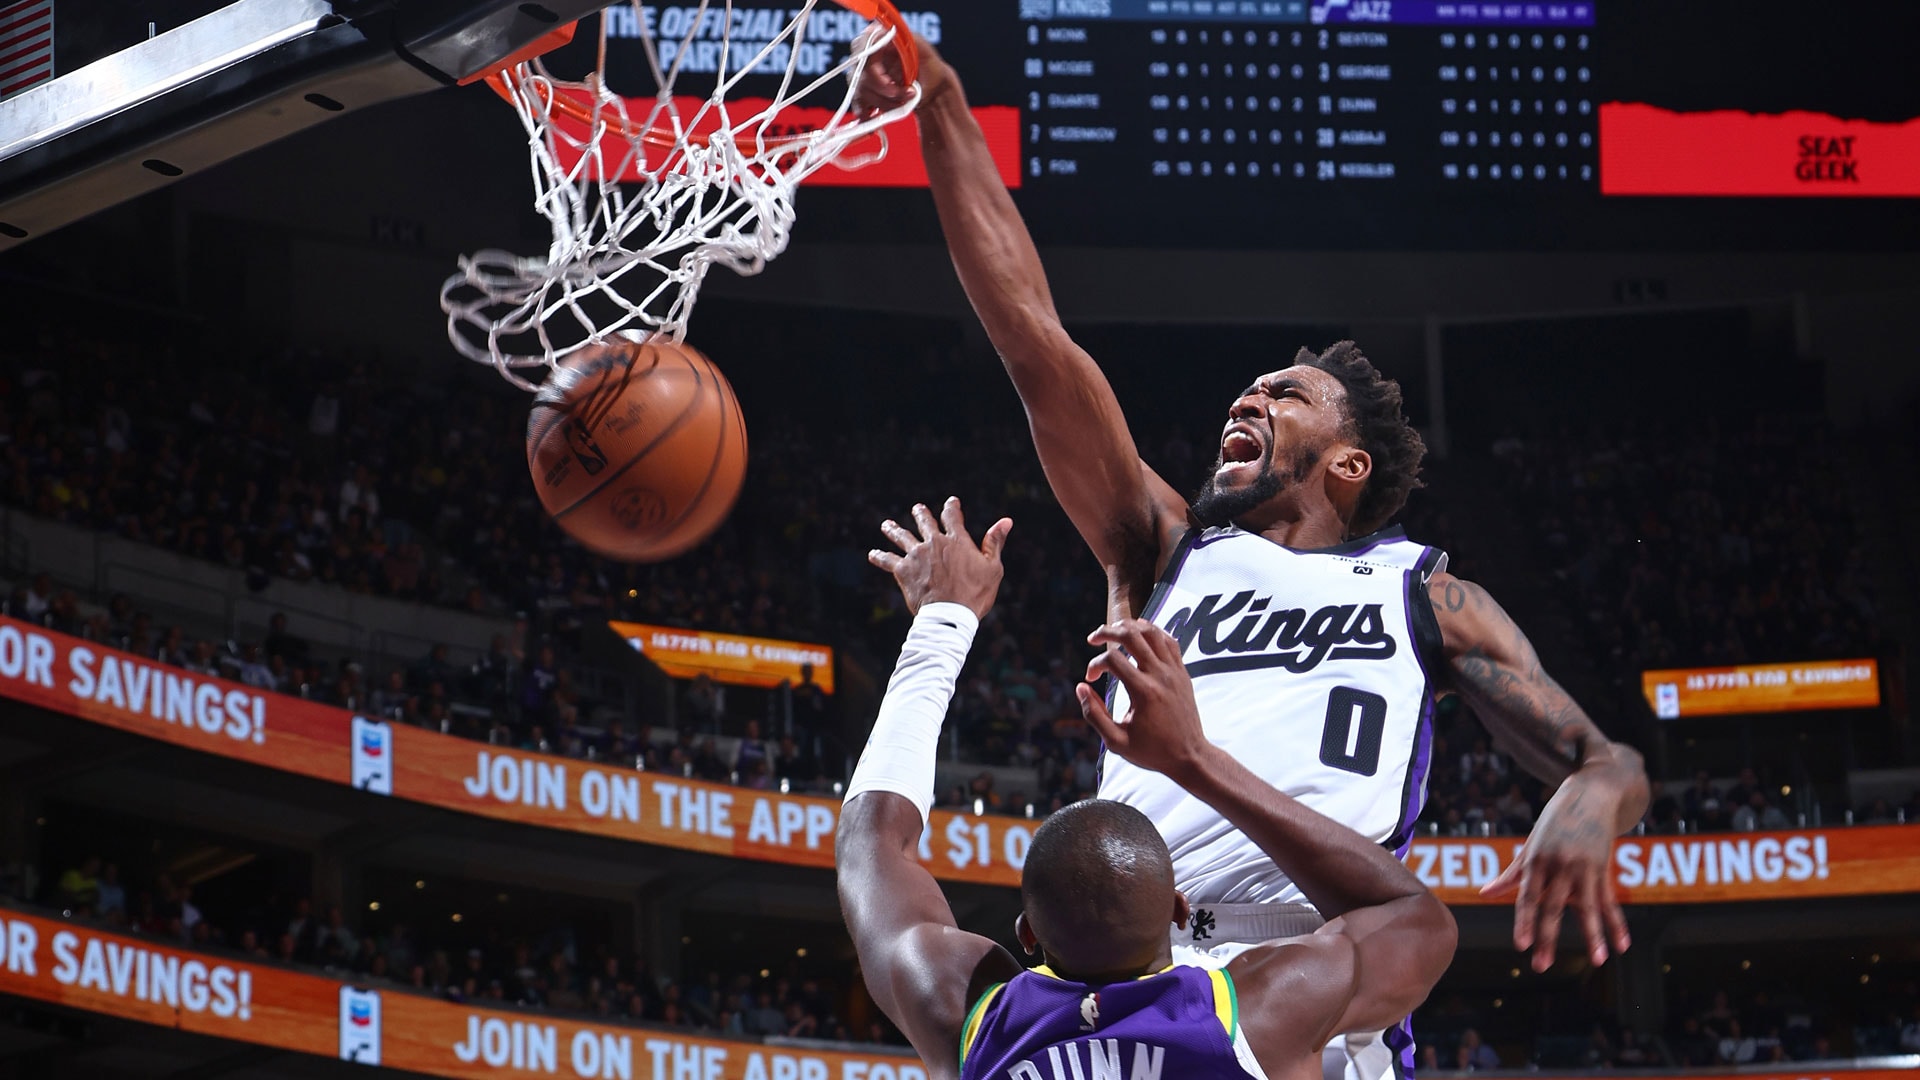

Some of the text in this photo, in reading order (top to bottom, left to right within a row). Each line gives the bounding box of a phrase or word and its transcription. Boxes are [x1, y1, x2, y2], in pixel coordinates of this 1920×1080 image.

[607, 6, 657, 37] THE
[660, 8, 784, 39] OFFICIAL
[1347, 0, 1392, 21] JAZZ
[658, 41, 832, 75] PARTNER OF
[1318, 29, 1329, 49] 2
[1049, 159, 1077, 174] FOX
[1798, 135, 1855, 157] SEAT
[1795, 160, 1859, 182] GEEK
[1164, 589, 1396, 674] Kings
[69, 647, 266, 744] SAVINGS!
[1319, 685, 1388, 777] 0
[464, 750, 566, 812] JOIN
[580, 771, 640, 822] ON
[653, 782, 734, 838] THE
[747, 798, 834, 851] APP
[946, 815, 991, 869] $1
[1616, 836, 1830, 887] SAVINGS!
[52, 930, 252, 1021] SAVINGS!
[454, 1015, 556, 1073] JOIN
[571, 1030, 632, 1080] ON
[646, 1039, 727, 1080] THE
